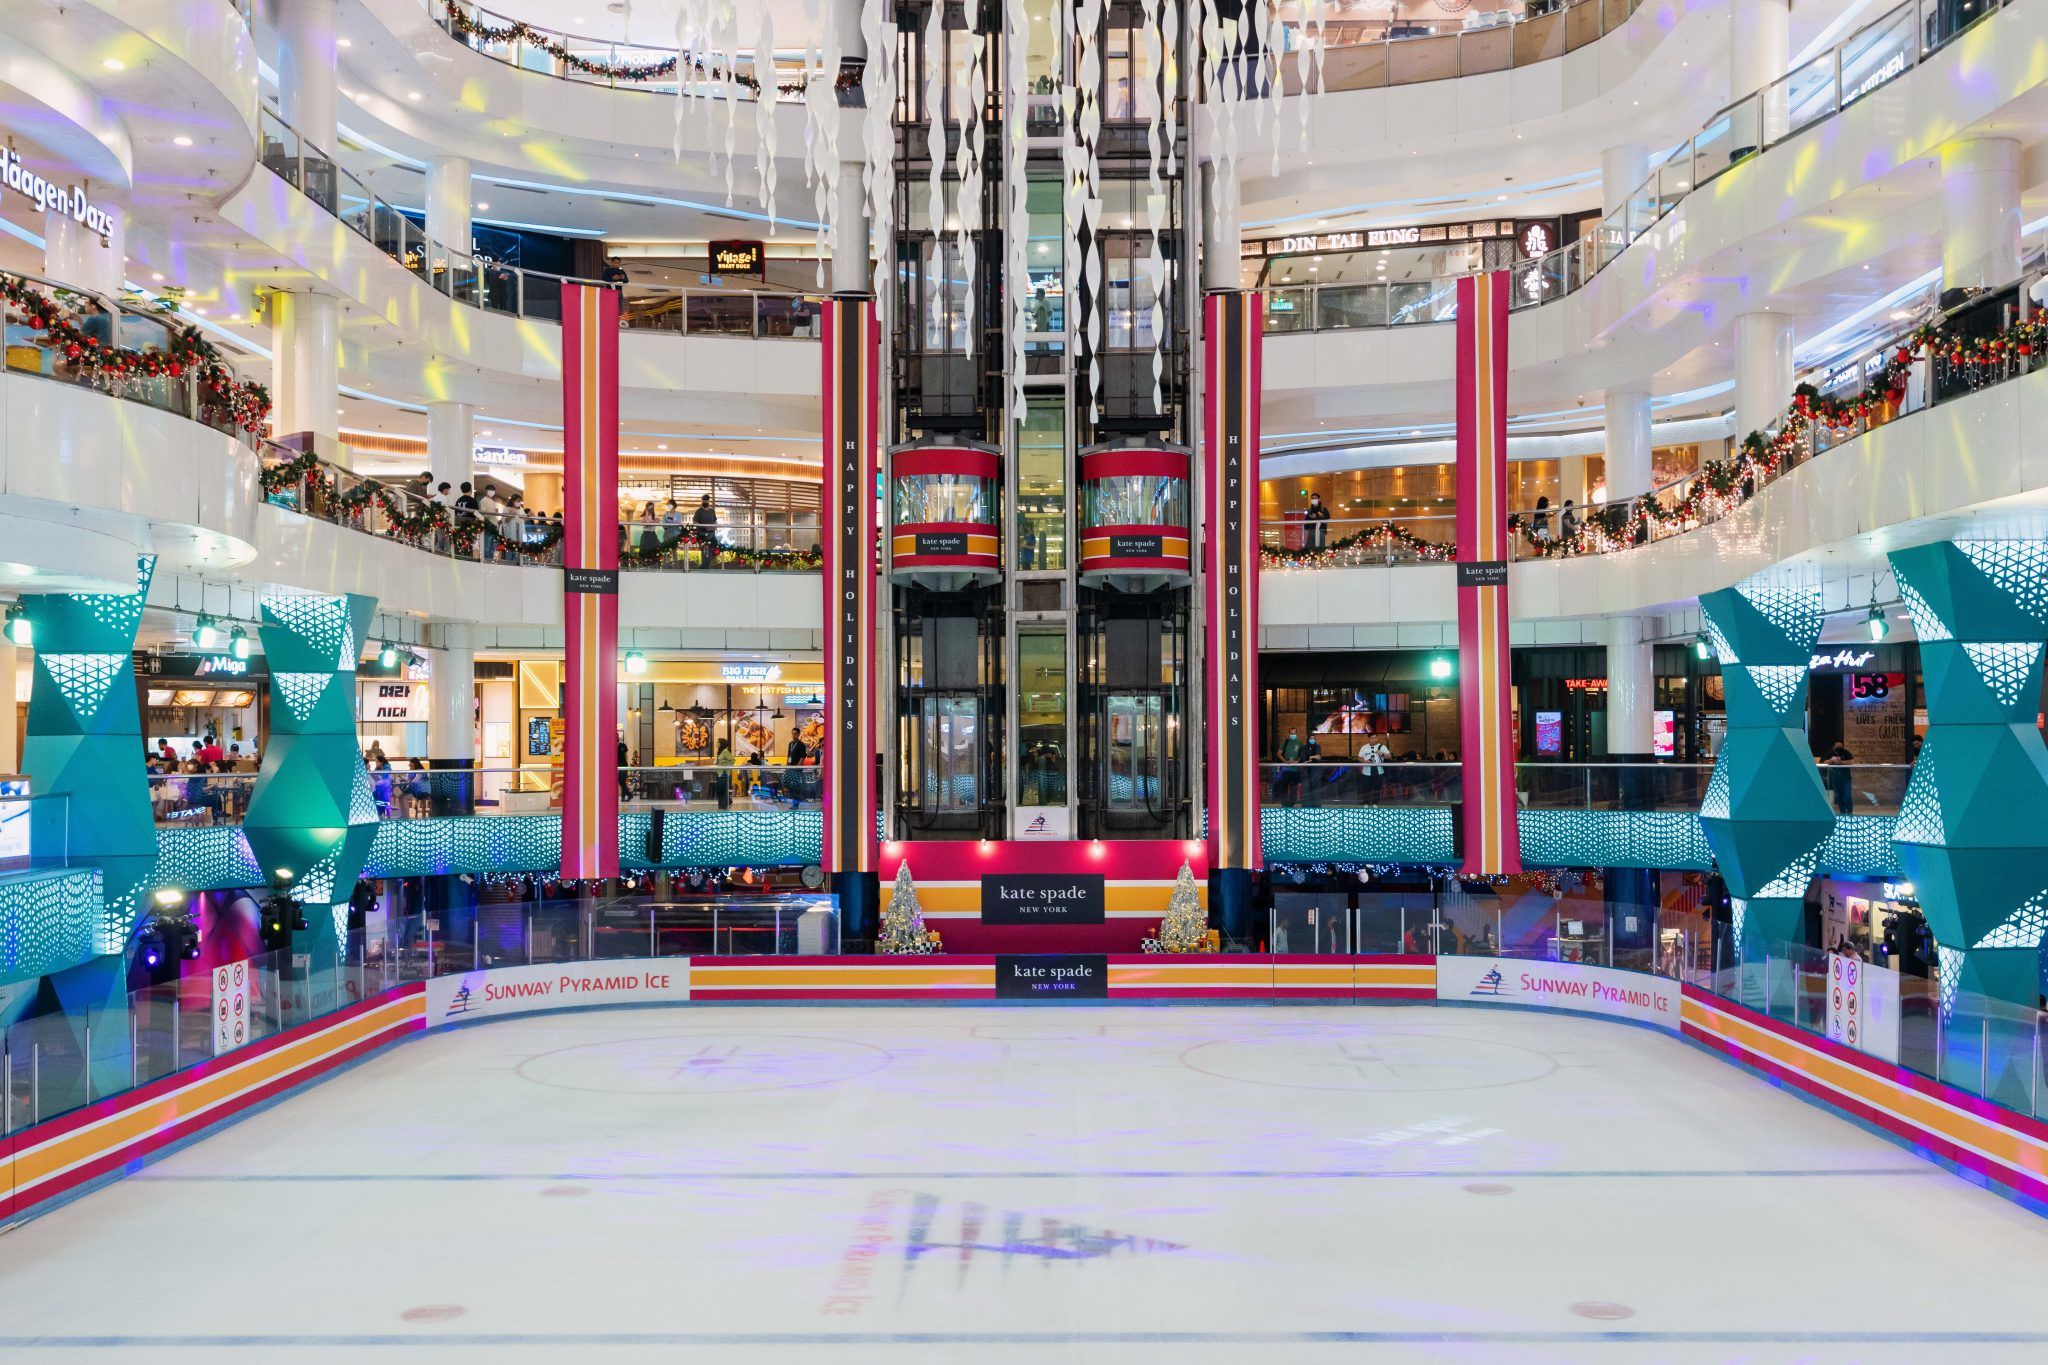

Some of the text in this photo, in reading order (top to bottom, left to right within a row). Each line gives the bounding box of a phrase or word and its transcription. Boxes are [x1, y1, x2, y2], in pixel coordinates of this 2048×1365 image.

[1283, 228, 1420, 252] DIN TAI FUNG
[474, 447, 526, 464] Garden
[845, 441, 855, 536] HAPPY
[1228, 436, 1238, 531] HAPPY
[922, 537, 961, 546] kate spade
[1117, 539, 1156, 548] kate spade
[570, 573, 611, 583] kate spade
[1466, 567, 1483, 575] kate
[845, 569, 855, 730] HOLIDAYS
[1228, 565, 1239, 726] HOLIDAYS
[212, 656, 246, 675] Miga
[1833, 650, 1875, 668] Hut
[722, 666, 767, 676] BIG FISH
[742, 687, 756, 695] THE
[1000, 885, 1087, 903] kate spade
[1014, 964, 1093, 981] kate spade
[485, 973, 670, 1001] SUNWAY PYRAMID ICE
[1520, 972, 1668, 1013] SUNWAY PYRAMID ICE
